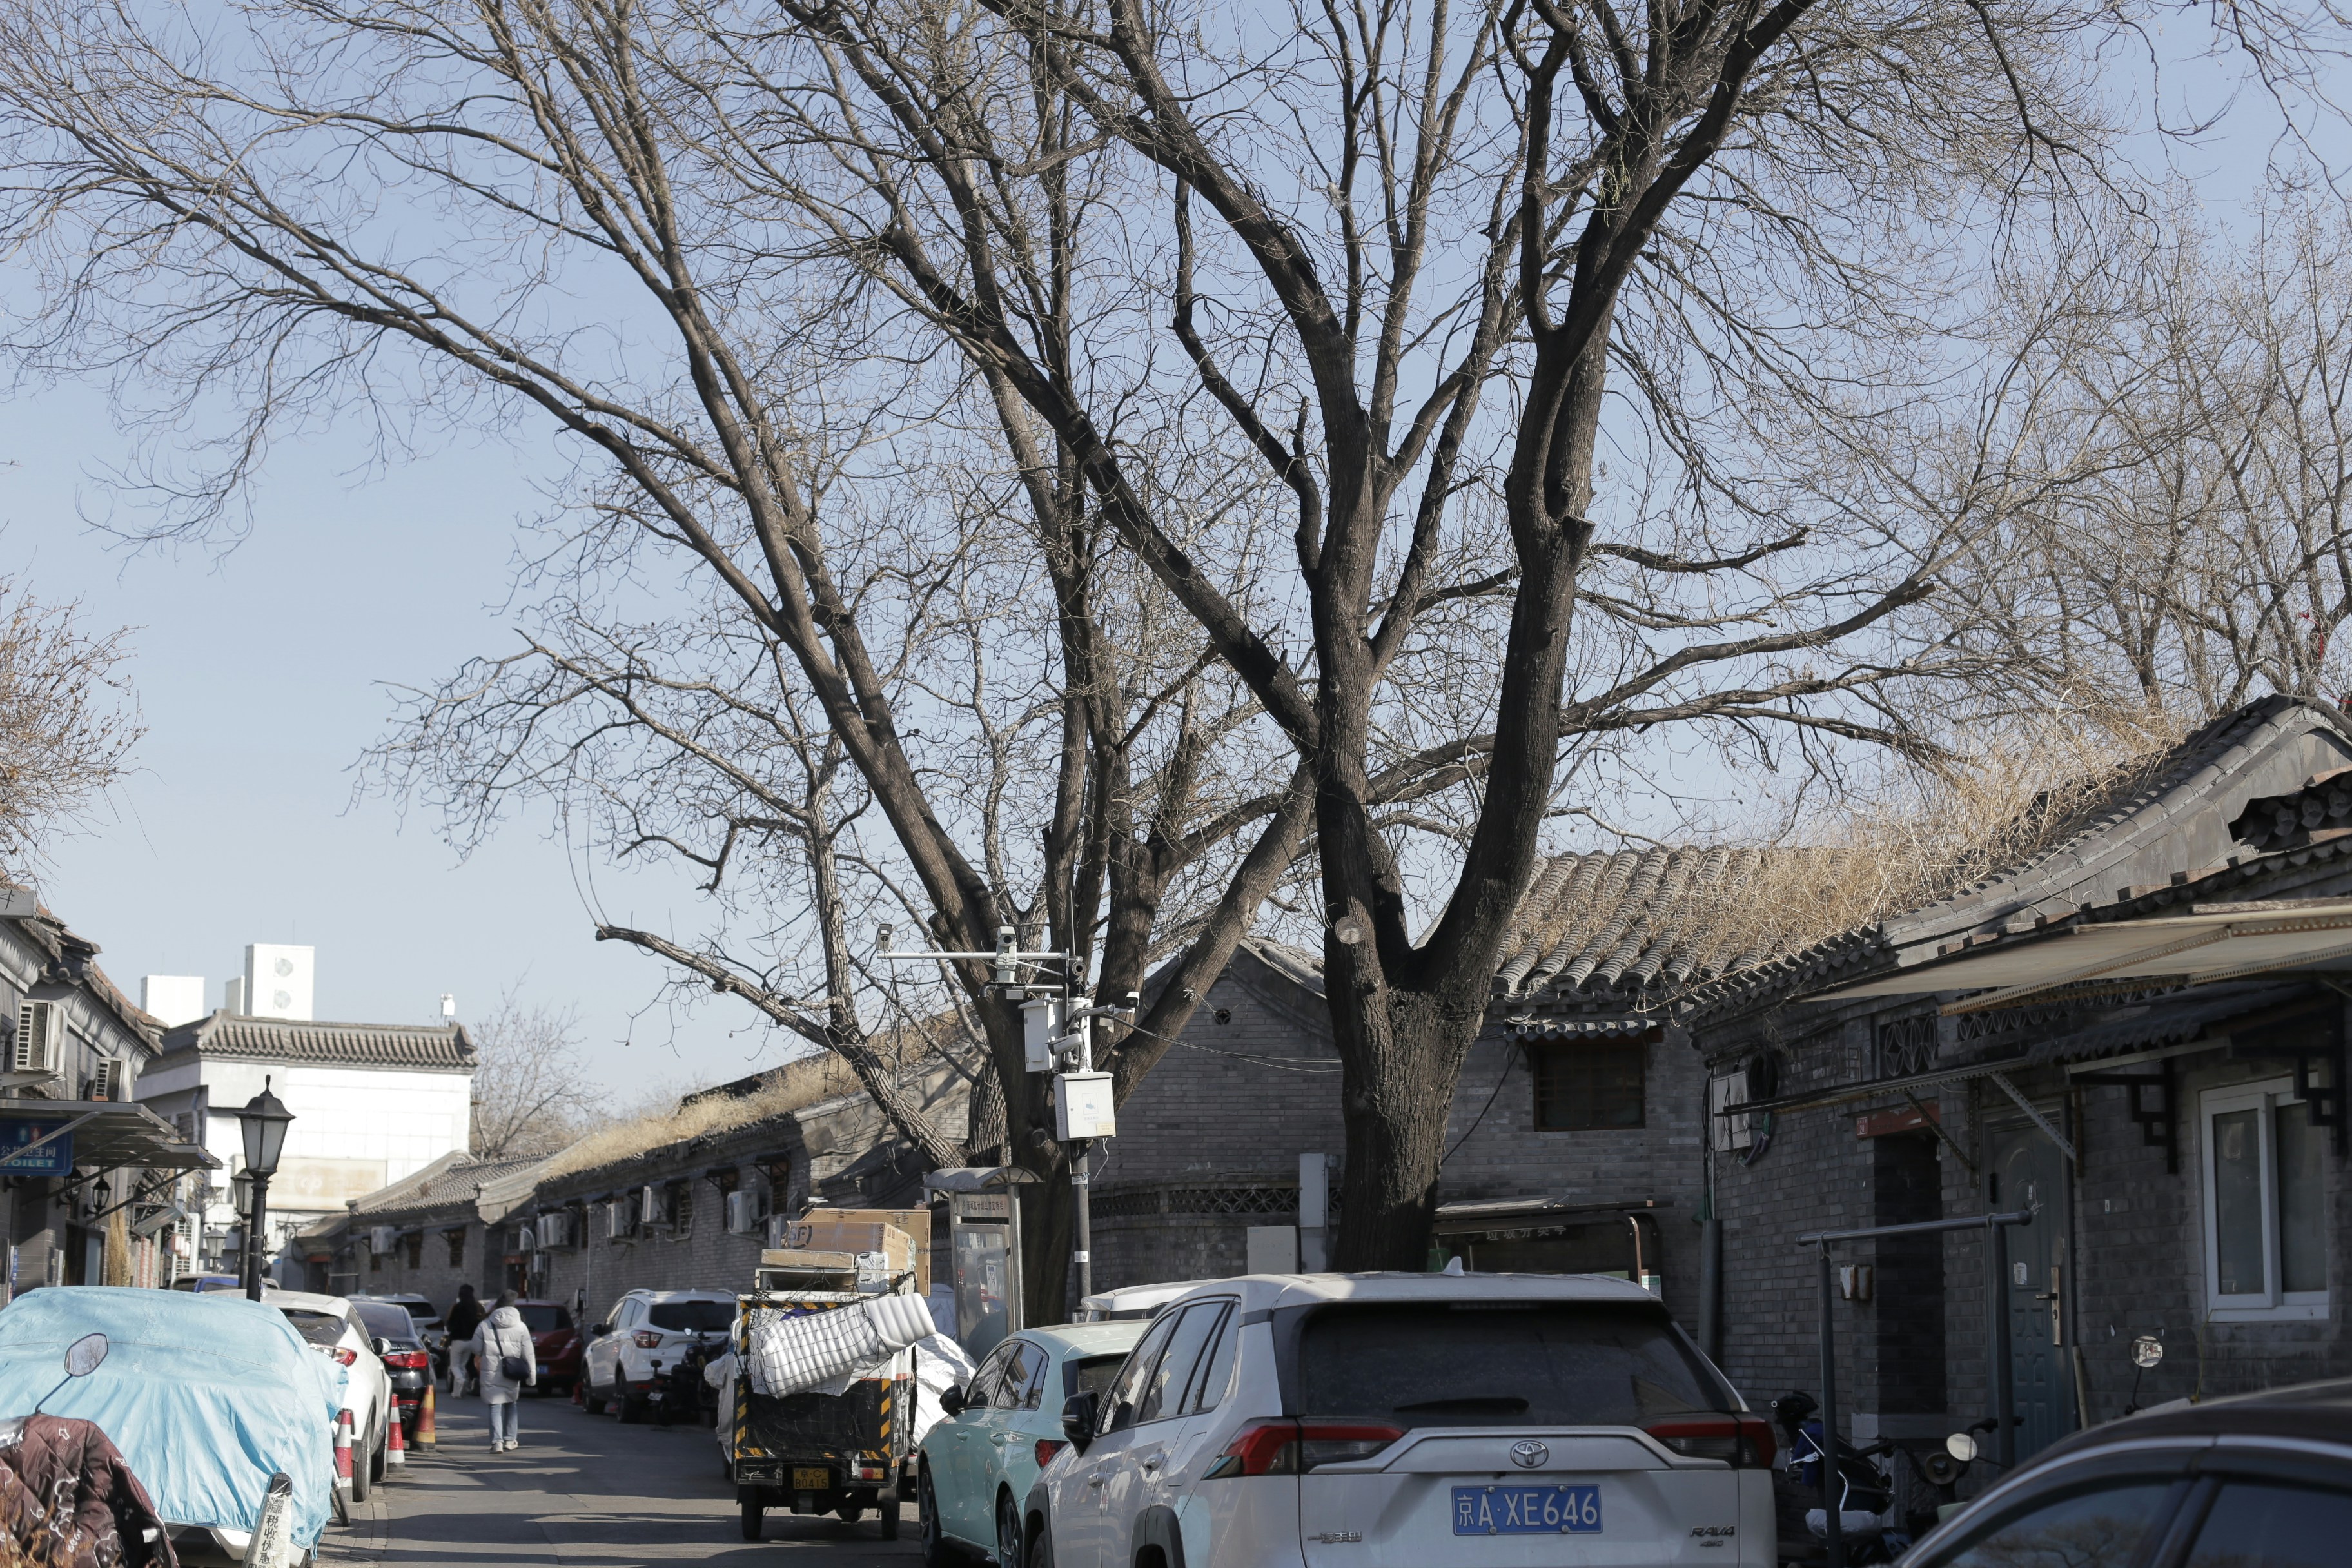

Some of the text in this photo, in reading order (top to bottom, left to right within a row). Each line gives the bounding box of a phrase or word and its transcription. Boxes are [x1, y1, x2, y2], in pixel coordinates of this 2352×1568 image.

[795, 1478, 827, 1488] B0415
[1690, 1525, 1735, 1537] RAV4
[1307, 1531, 1362, 1544] 一汽丰田
